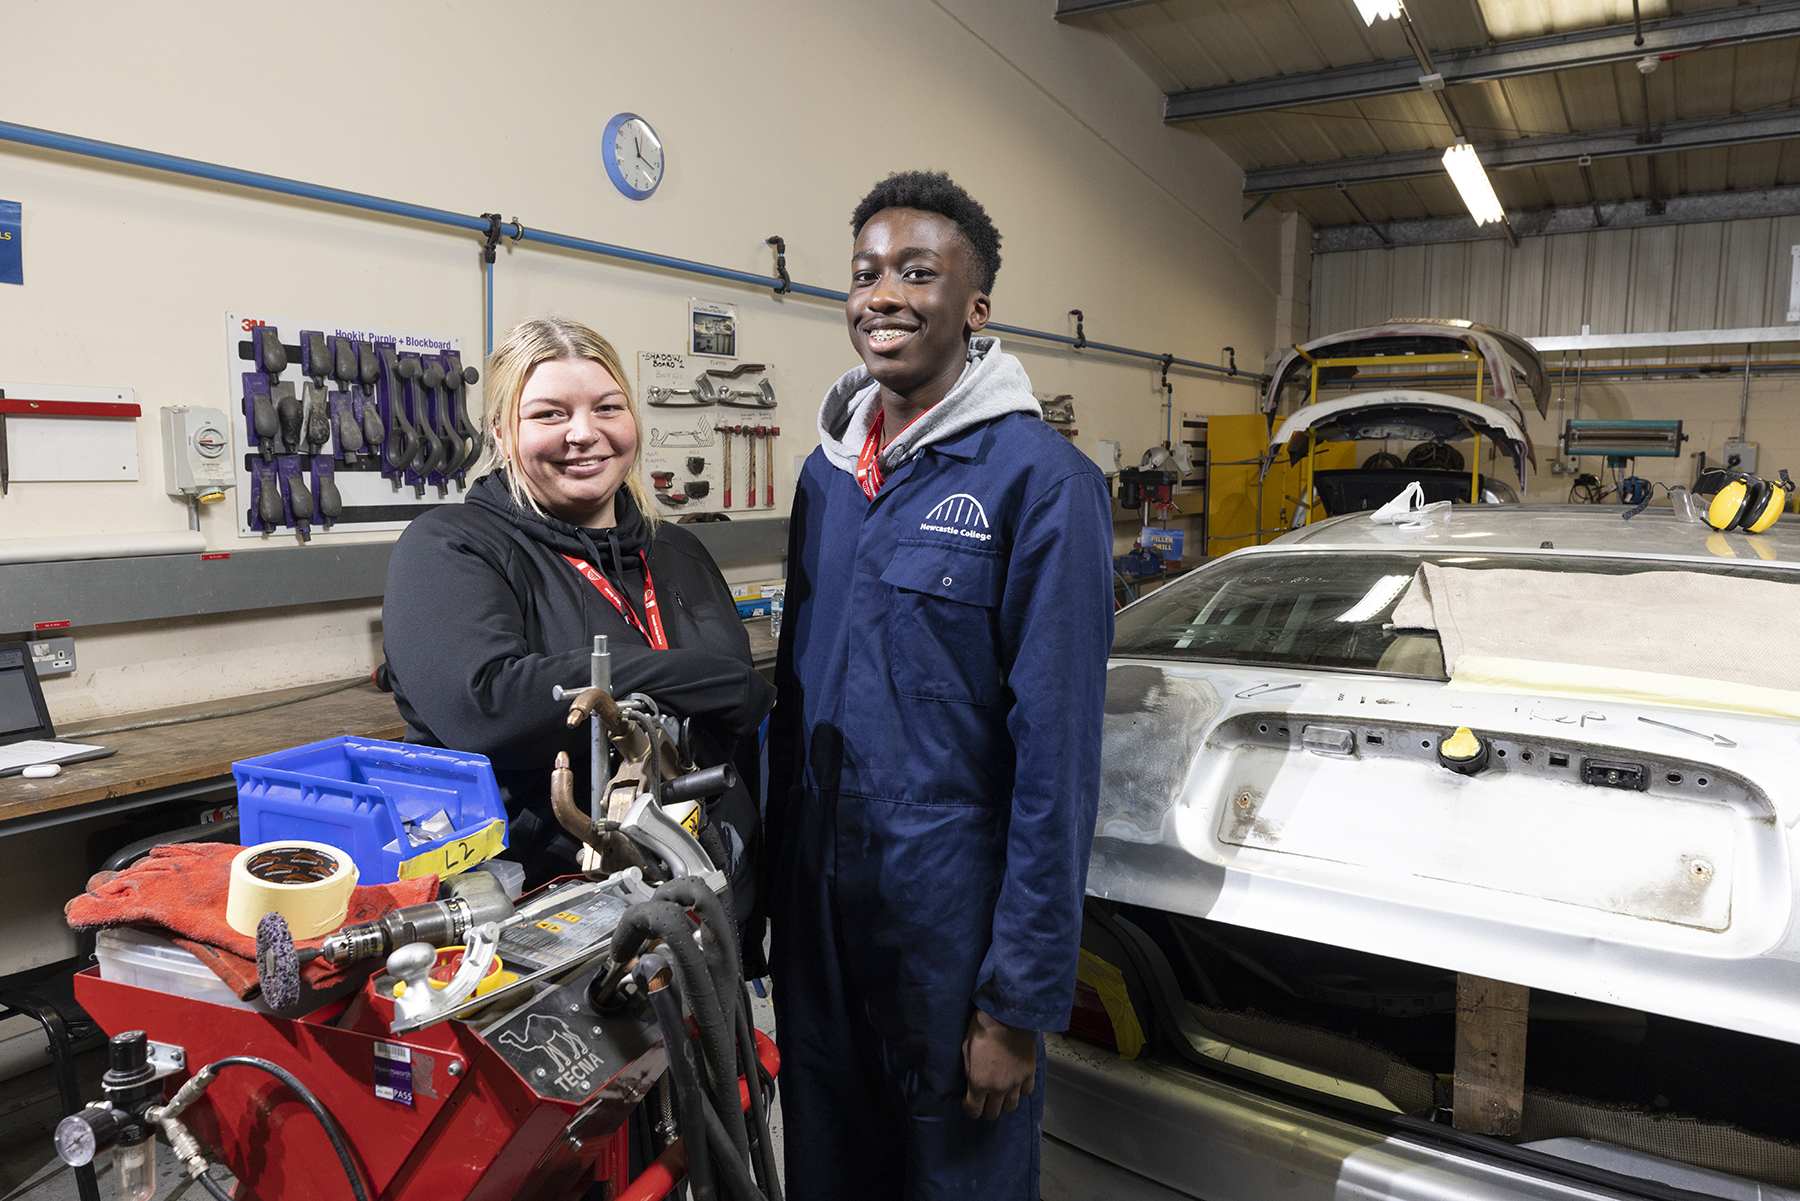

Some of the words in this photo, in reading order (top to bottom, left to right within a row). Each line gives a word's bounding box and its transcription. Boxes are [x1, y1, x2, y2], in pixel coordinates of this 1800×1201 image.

[405, 336, 452, 350] Blockboard
[919, 522, 959, 535] Newcastle
[959, 529, 992, 541] College
[553, 1052, 605, 1092] TECNA
